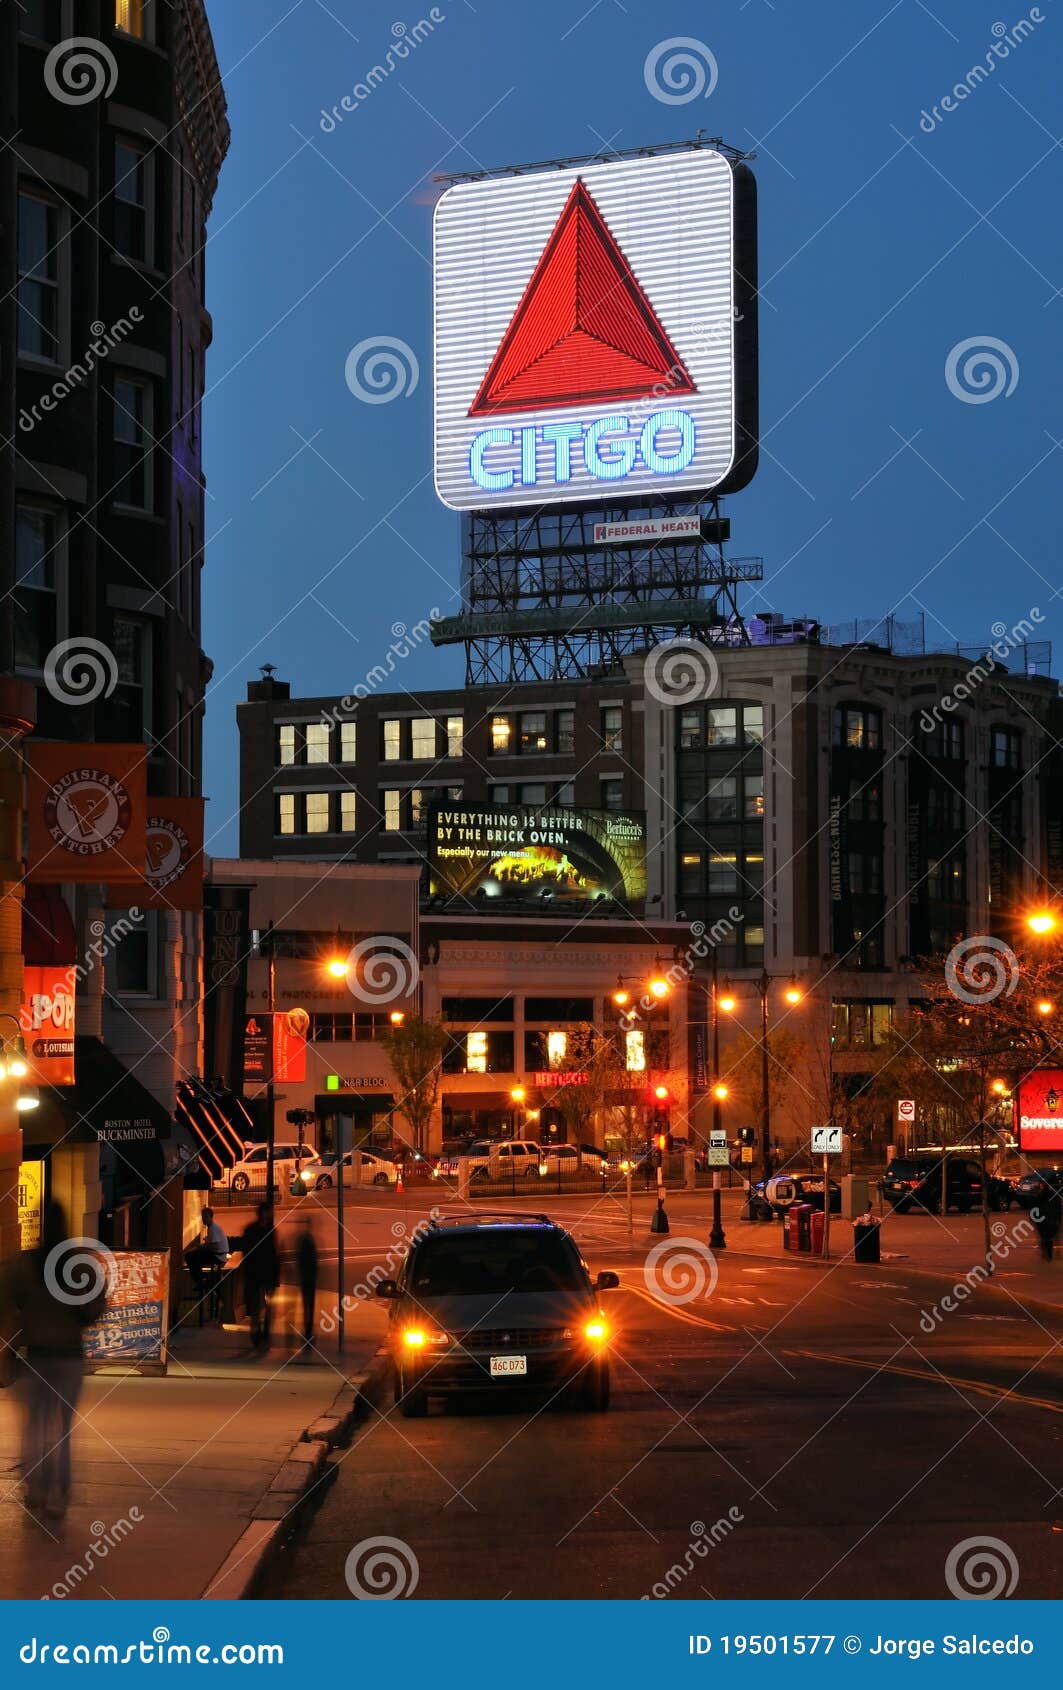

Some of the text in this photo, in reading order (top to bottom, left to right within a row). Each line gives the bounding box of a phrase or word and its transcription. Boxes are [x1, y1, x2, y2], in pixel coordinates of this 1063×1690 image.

[469, 409, 697, 491] CITGO
[607, 521, 699, 537] FEDERAL HEATH
[47, 769, 129, 806] LOUISIANA
[437, 812, 583, 831] EVERYTHING IS BETTER
[49, 824, 127, 855] KITCHEN
[437, 827, 570, 845] BY THE BRICK OVEN.
[437, 846, 475, 859] Especially
[476, 849, 490, 857] our
[491, 849, 507, 858] new
[104, 1119, 131, 1128] BOSTON
[97, 1128, 157, 1141] BUCKMINSTER
[95, 1328, 124, 1350] 12
